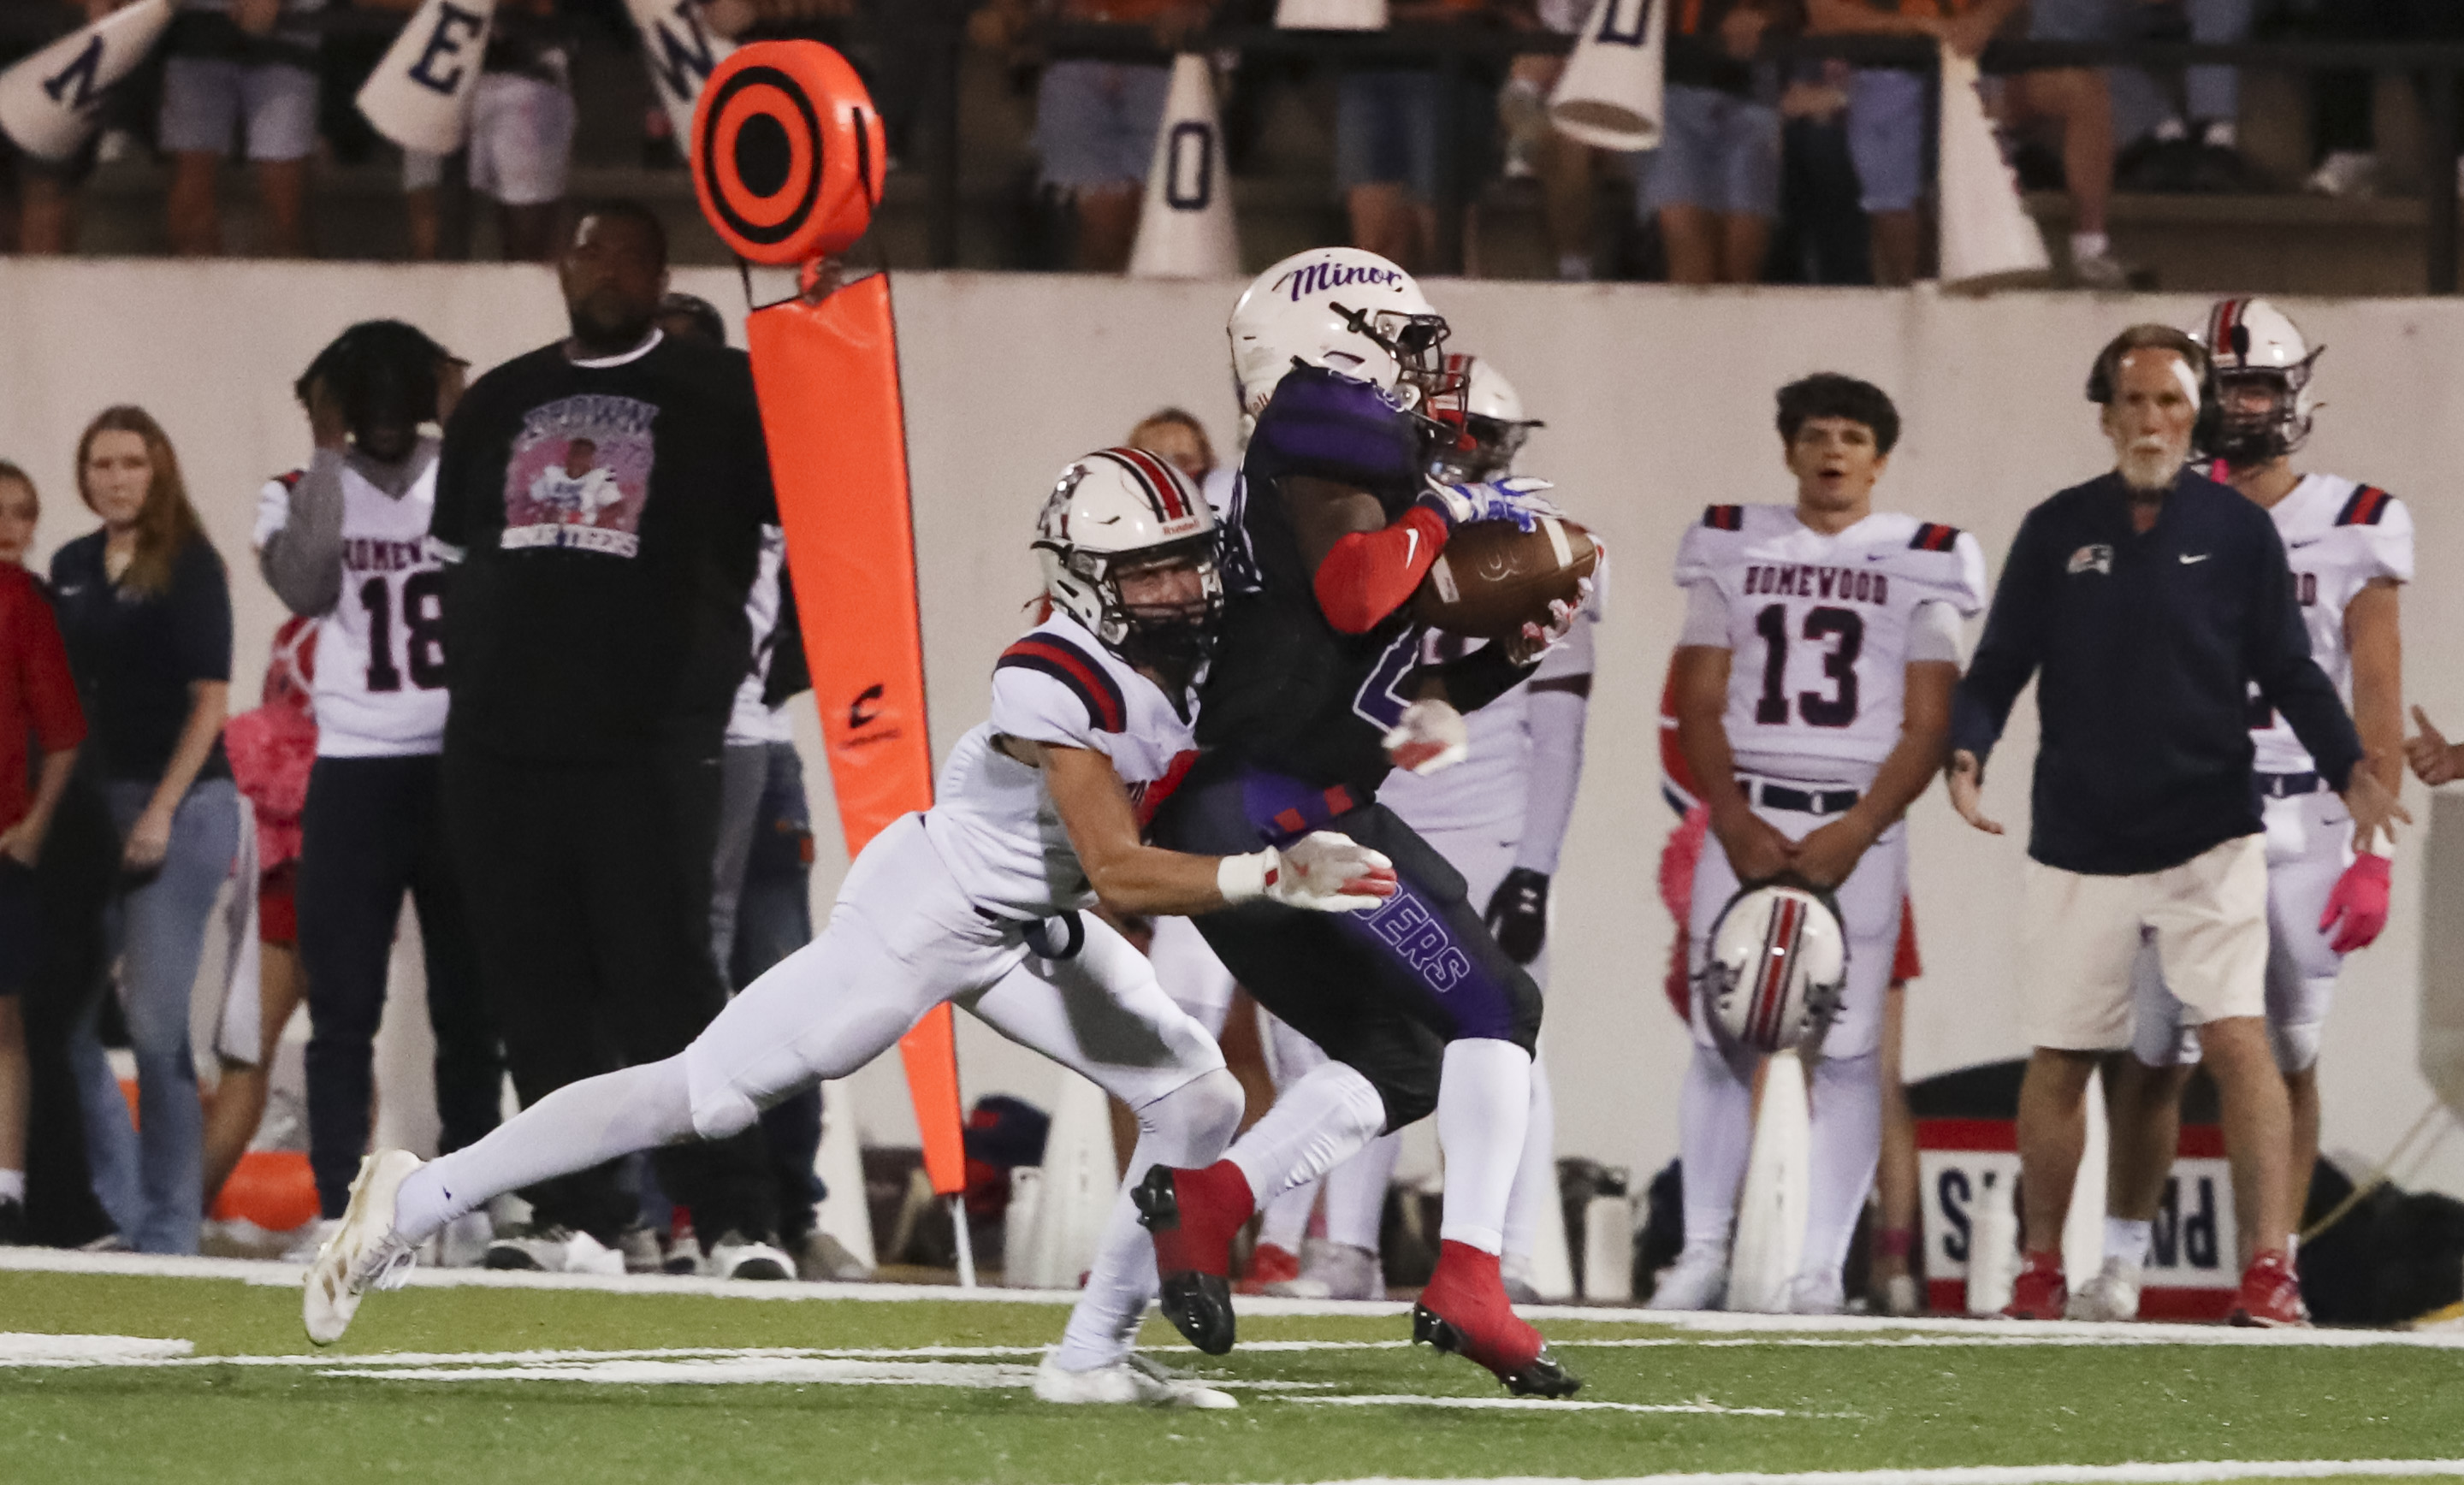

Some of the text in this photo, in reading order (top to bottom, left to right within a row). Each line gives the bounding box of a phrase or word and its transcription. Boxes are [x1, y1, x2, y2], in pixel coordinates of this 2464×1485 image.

[409, 0, 483, 96] E
[1289, 262, 1402, 301] Minor
[360, 572, 453, 694] 18
[1744, 565, 1889, 606] HOMEWOOD
[1756, 602, 1866, 730] 13
